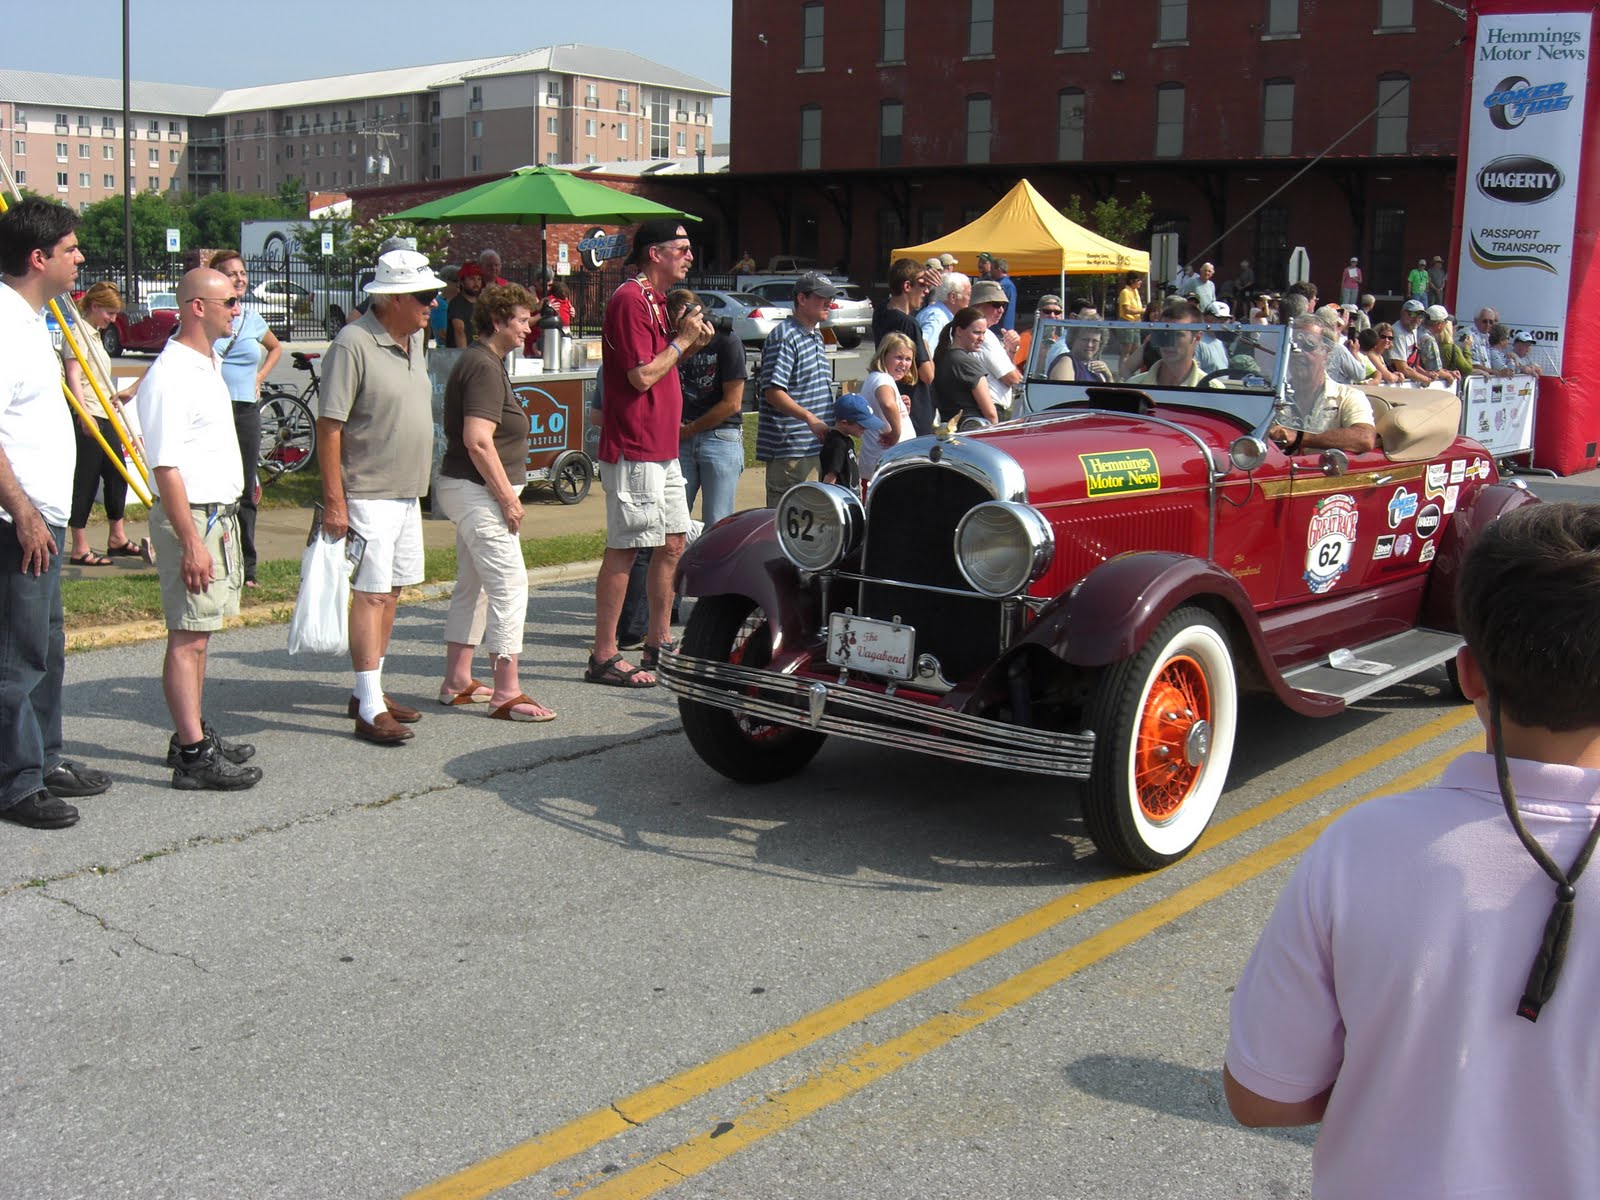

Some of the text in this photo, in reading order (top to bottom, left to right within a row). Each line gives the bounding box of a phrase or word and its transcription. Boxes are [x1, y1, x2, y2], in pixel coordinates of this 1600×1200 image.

[1487, 27, 1581, 46] Hemmings
[1480, 45, 1585, 61] Motor News
[1483, 82, 1567, 108] COKER
[1512, 96, 1574, 118] TIRE
[1483, 173, 1556, 188] HAGERTY
[577, 234, 627, 252] COKER
[1480, 229, 1540, 239] PASSPORT
[1492, 242, 1561, 254] TRANSPORT
[529, 412, 565, 434] LO
[527, 435, 563, 446] OASTERS
[1088, 455, 1151, 473] Hemmings
[1089, 470, 1158, 489] Motor News
[785, 506, 815, 541] 62
[1318, 541, 1342, 568] 62
[863, 632, 878, 642] The
[857, 645, 907, 665] Vagabond
